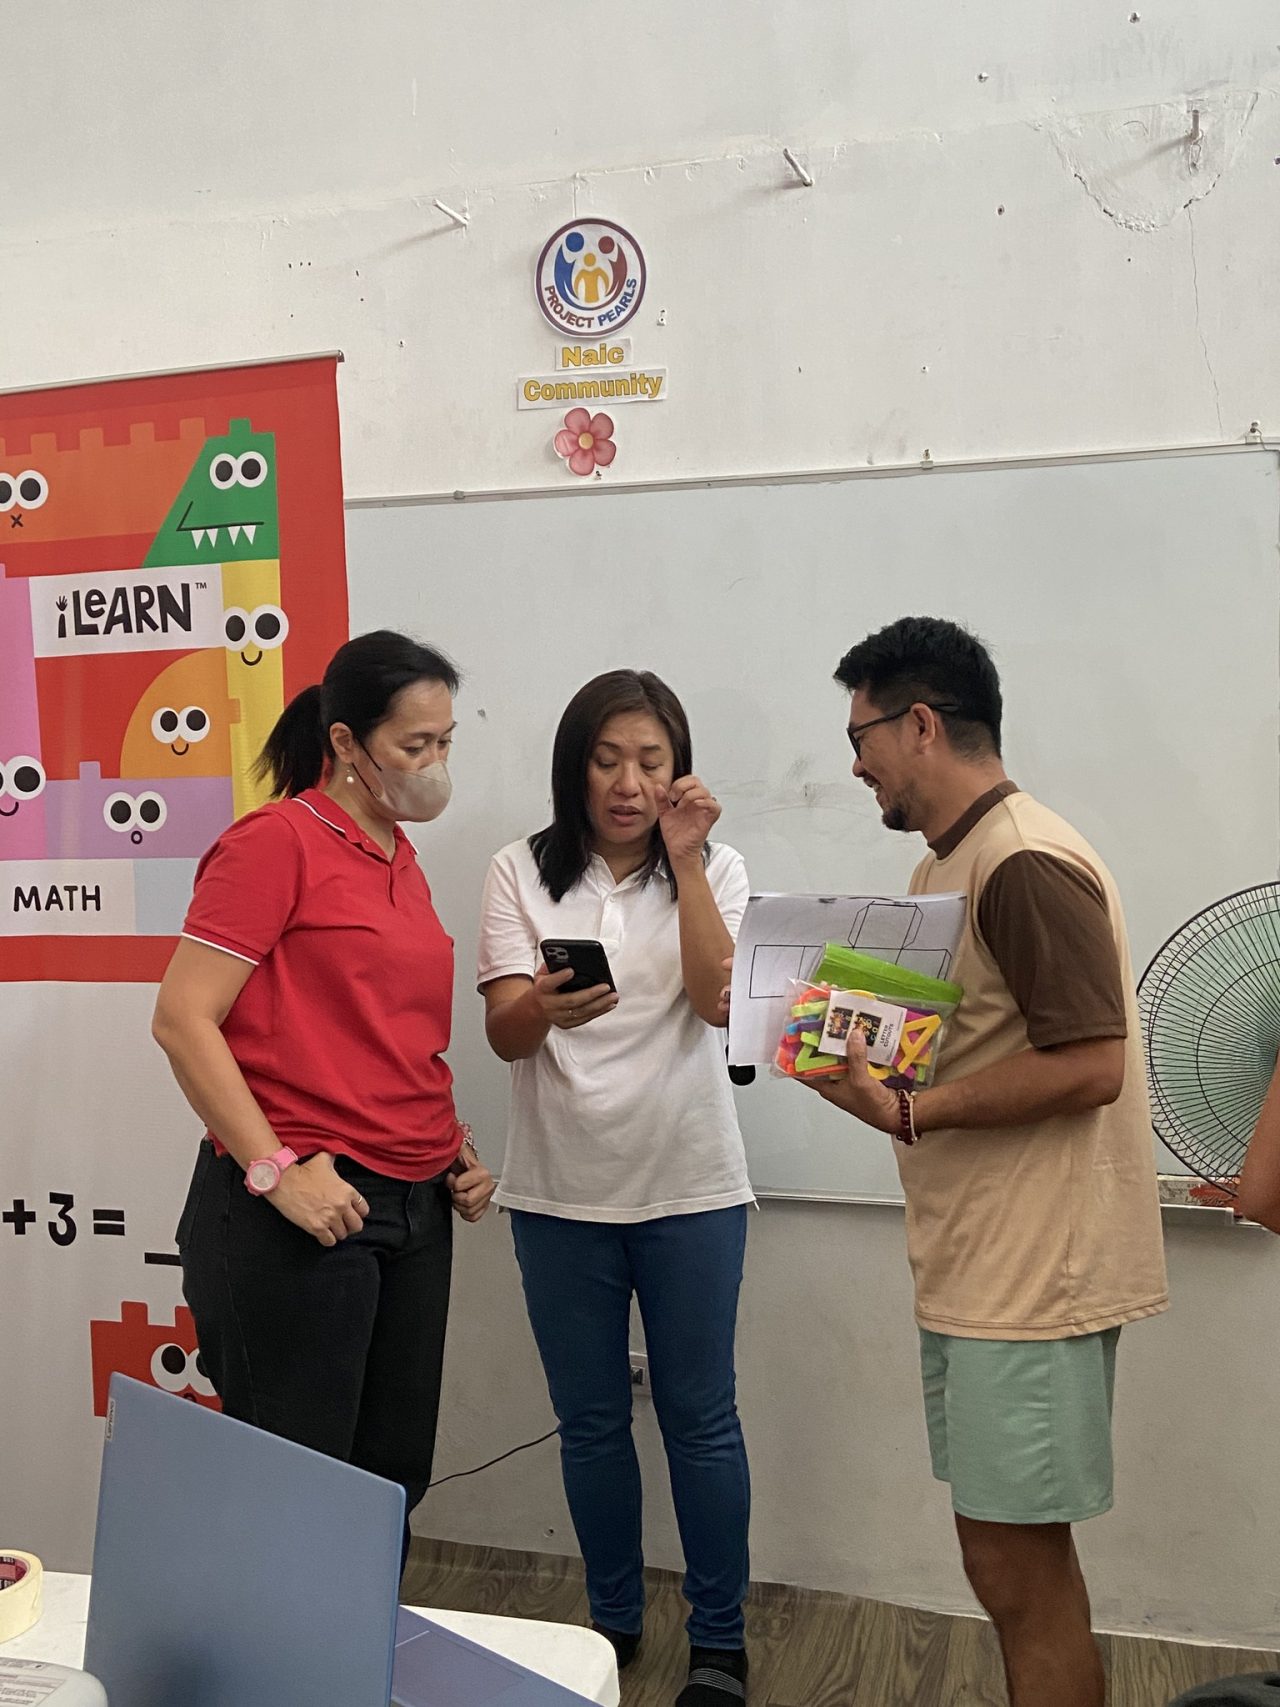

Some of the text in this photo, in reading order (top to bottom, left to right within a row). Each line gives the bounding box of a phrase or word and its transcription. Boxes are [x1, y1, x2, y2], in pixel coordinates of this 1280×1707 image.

[544, 278, 637, 329] PROJECT PEARLS
[561, 343, 624, 368] Naic
[523, 373, 663, 402] Community
[13, 884, 101, 912] MATH
[880, 1024, 888, 1044] LETTER
[883, 1023, 894, 1048] CUTOUTS
[48, 1191, 77, 1246] 3
